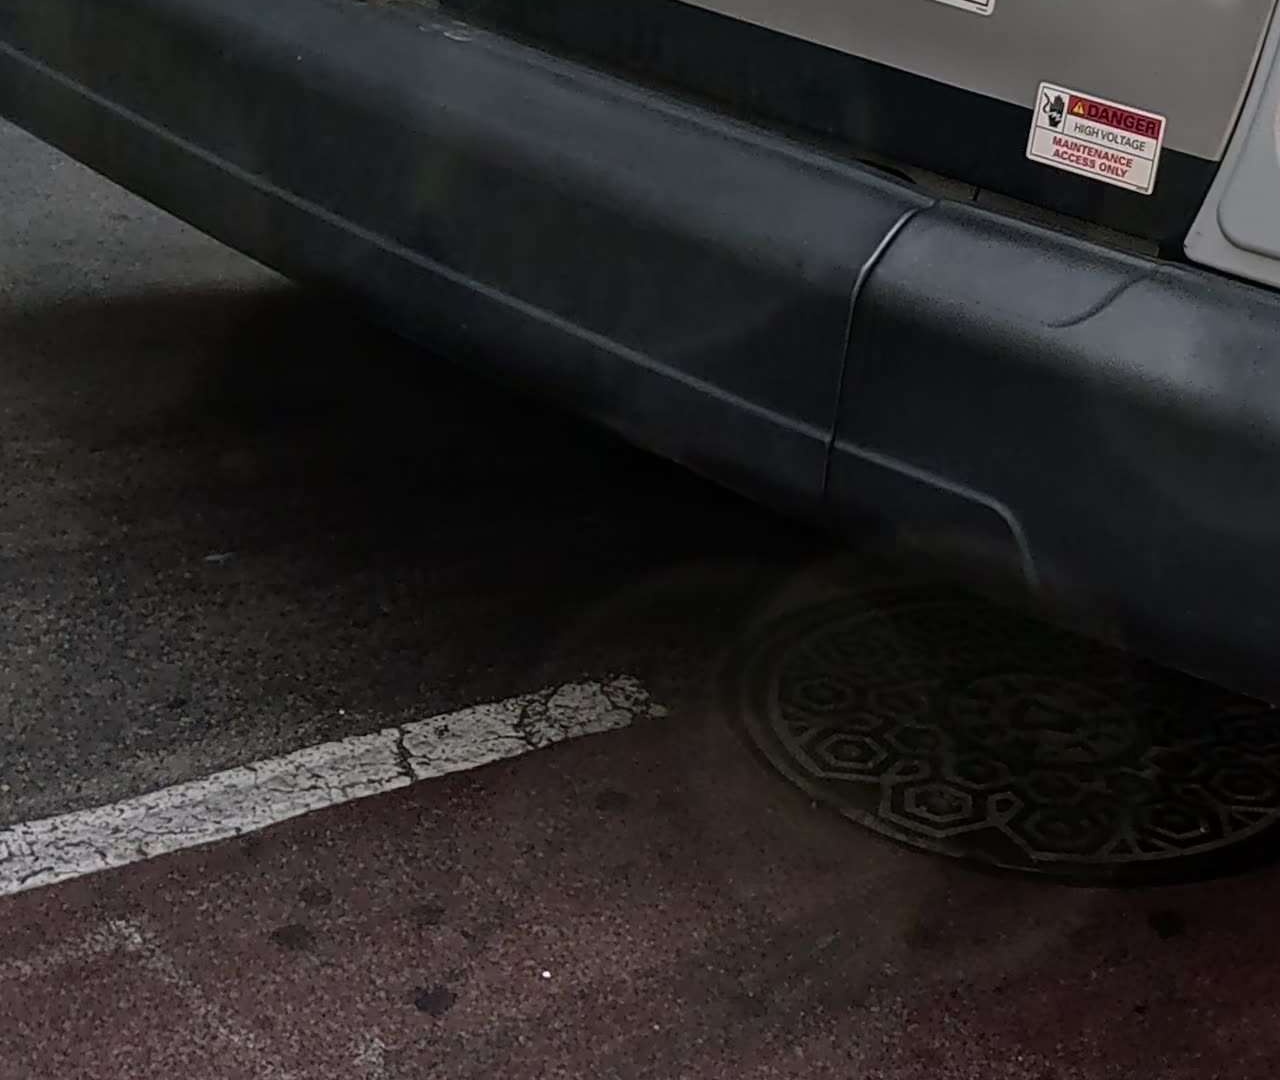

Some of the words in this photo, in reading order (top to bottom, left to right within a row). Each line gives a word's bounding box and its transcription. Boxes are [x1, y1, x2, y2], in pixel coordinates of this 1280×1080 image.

[1087, 104, 1156, 135] DANGER
[1052, 136, 1134, 168] MAINTENANCE
[1073, 122, 1100, 139] HIGH
[1099, 129, 1146, 152] VOLTAGE
[1053, 149, 1096, 169] ACCESS
[1098, 162, 1128, 178] ONLY
